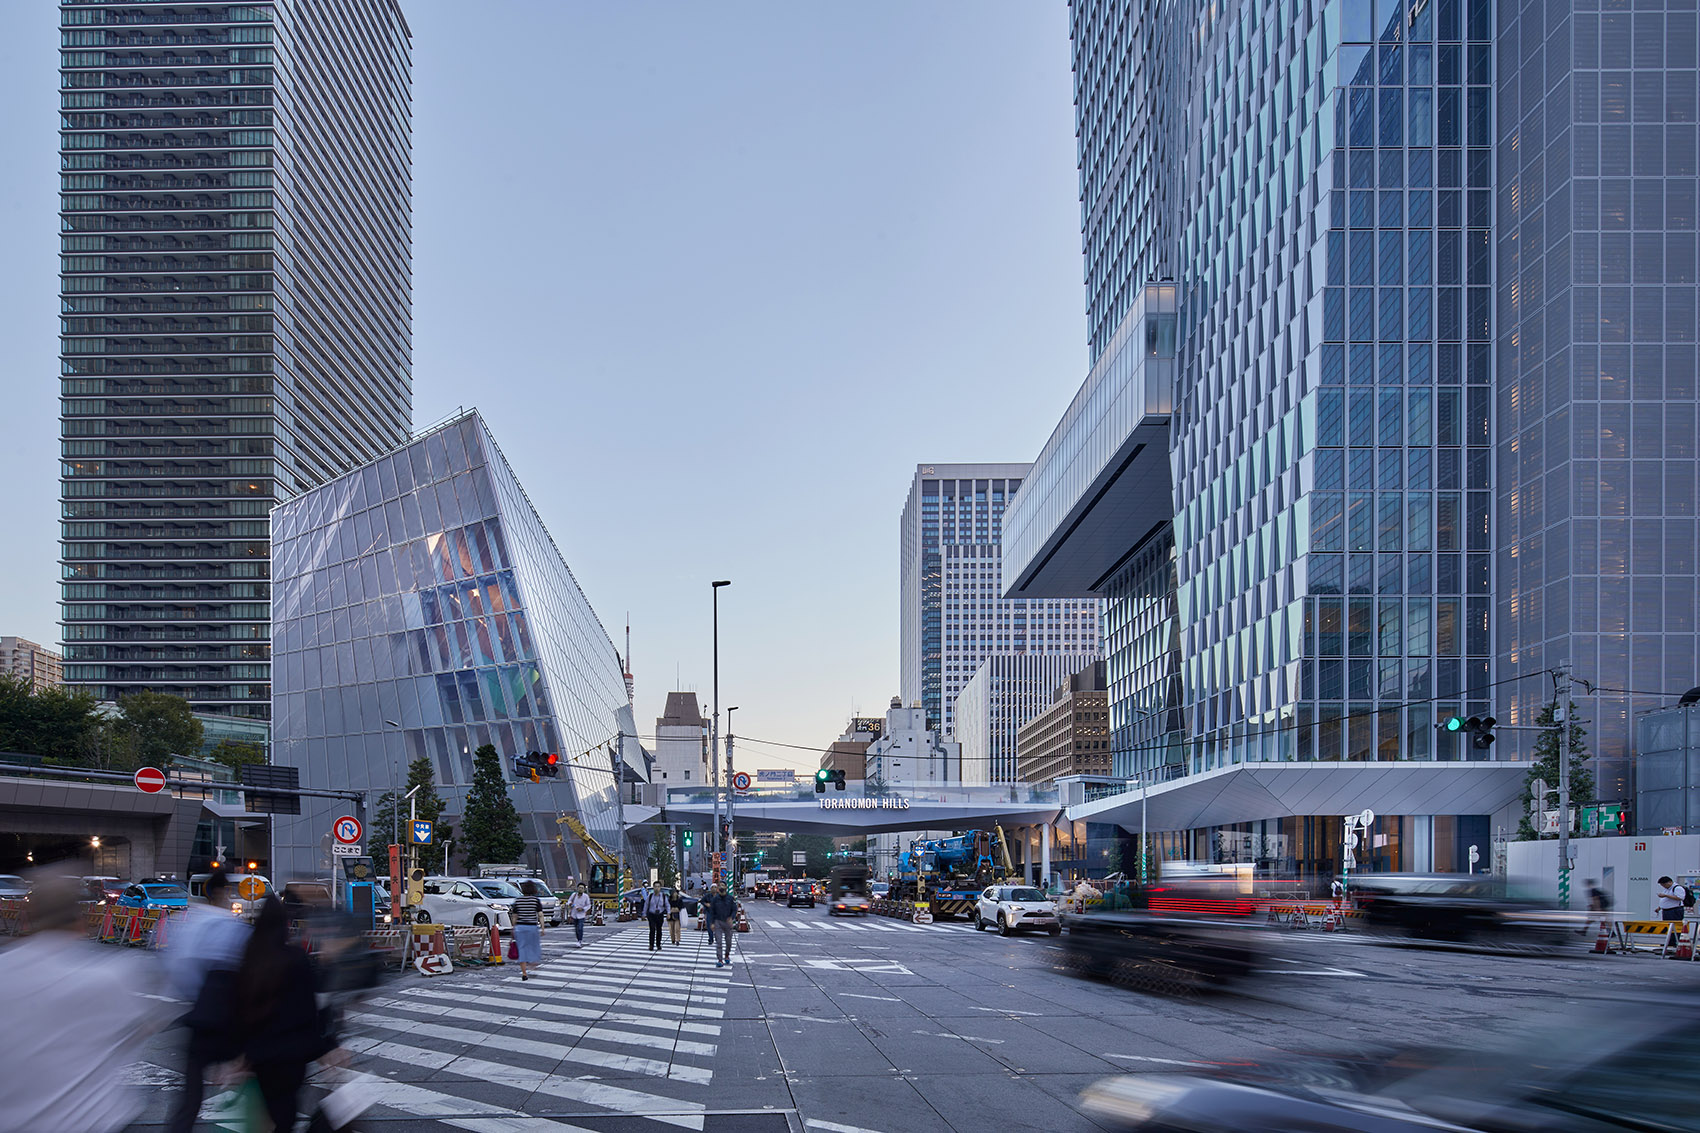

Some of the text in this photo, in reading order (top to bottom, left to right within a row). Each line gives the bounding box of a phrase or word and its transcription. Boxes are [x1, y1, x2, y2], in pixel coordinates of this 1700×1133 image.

[868, 722, 881, 731] 36
[819, 798, 910, 809] TORANOMON HILLS
